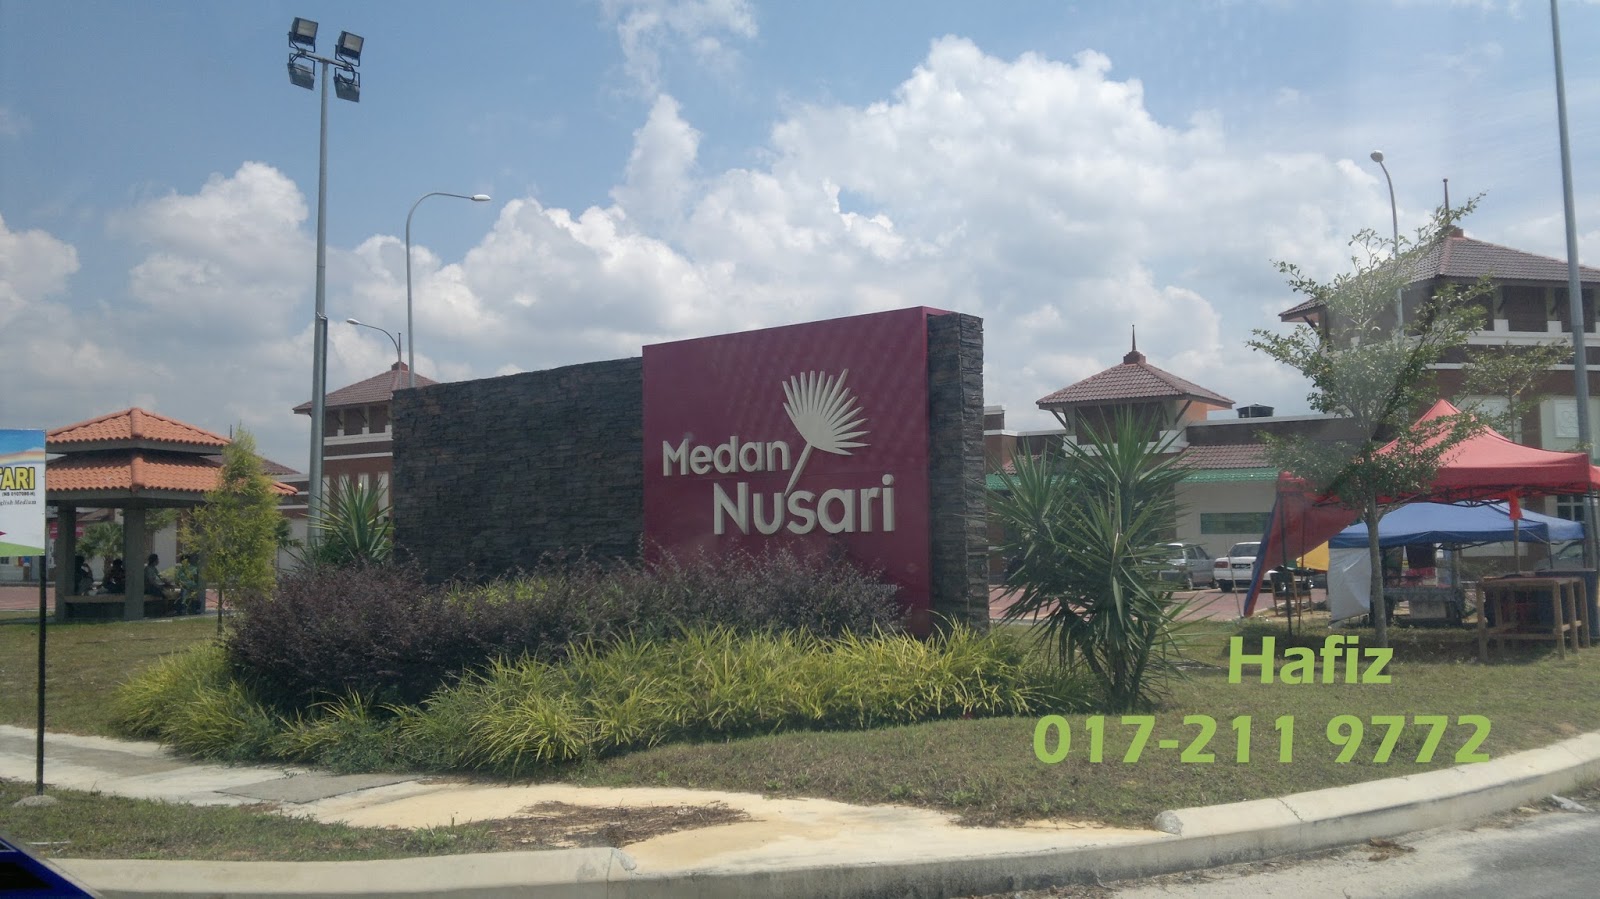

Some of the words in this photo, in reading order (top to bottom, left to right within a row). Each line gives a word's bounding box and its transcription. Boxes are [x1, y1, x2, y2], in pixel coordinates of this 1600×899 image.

[662, 435, 791, 477] Medan
[0, 467, 35, 490] ARI
[713, 474, 895, 535] Nusari
